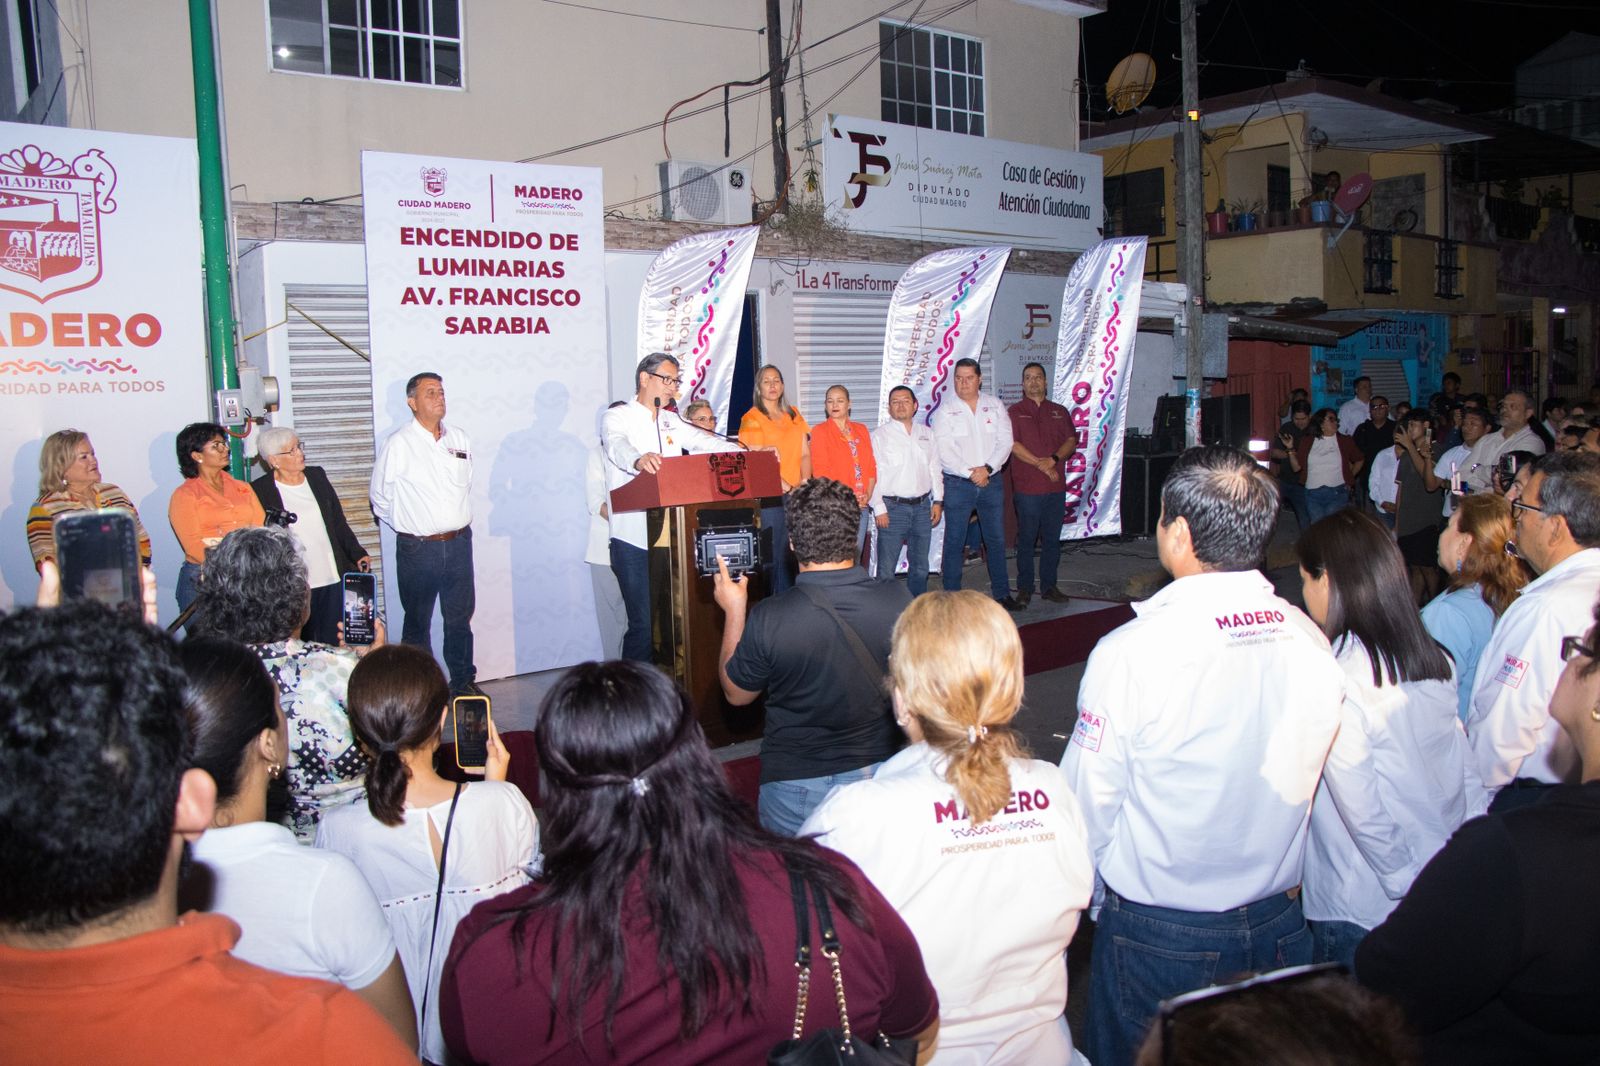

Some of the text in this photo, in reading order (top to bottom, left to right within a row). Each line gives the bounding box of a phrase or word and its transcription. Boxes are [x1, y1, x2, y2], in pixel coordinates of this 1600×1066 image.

[1003, 161, 1086, 192] Casa de Gestión y
[514, 184, 583, 201] MADERO
[908, 182, 970, 198] DIPUTADO
[912, 194, 967, 208] CIUDAD MADERO
[398, 199, 471, 210] CIUDAD MADERO
[999, 190, 1091, 221] Atención Ciudadana
[81, 192, 96, 266] TAMAULIPAS
[400, 226, 579, 251] ENCENDIDO DE
[418, 257, 565, 279] LUMINARIAS
[400, 286, 581, 307] AV. FRANCISCO
[0, 312, 162, 348] DERO
[445, 316, 550, 335] SARABIA
[678, 294, 694, 348] TODOS
[903, 291, 933, 385] PROSPERIDAD
[916, 299, 944, 386] PARA TODOS
[1087, 341, 1097, 372] PARA
[58, 381, 103, 394] PARA
[109, 380, 165, 393] TODOS
[1064, 381, 1092, 525] MADERO
[1215, 610, 1285, 630] MADERO
[934, 788, 1050, 824] MERO
[940, 839, 1003, 856] PROSPERIDAD
[1004, 836, 1029, 847] PARA
